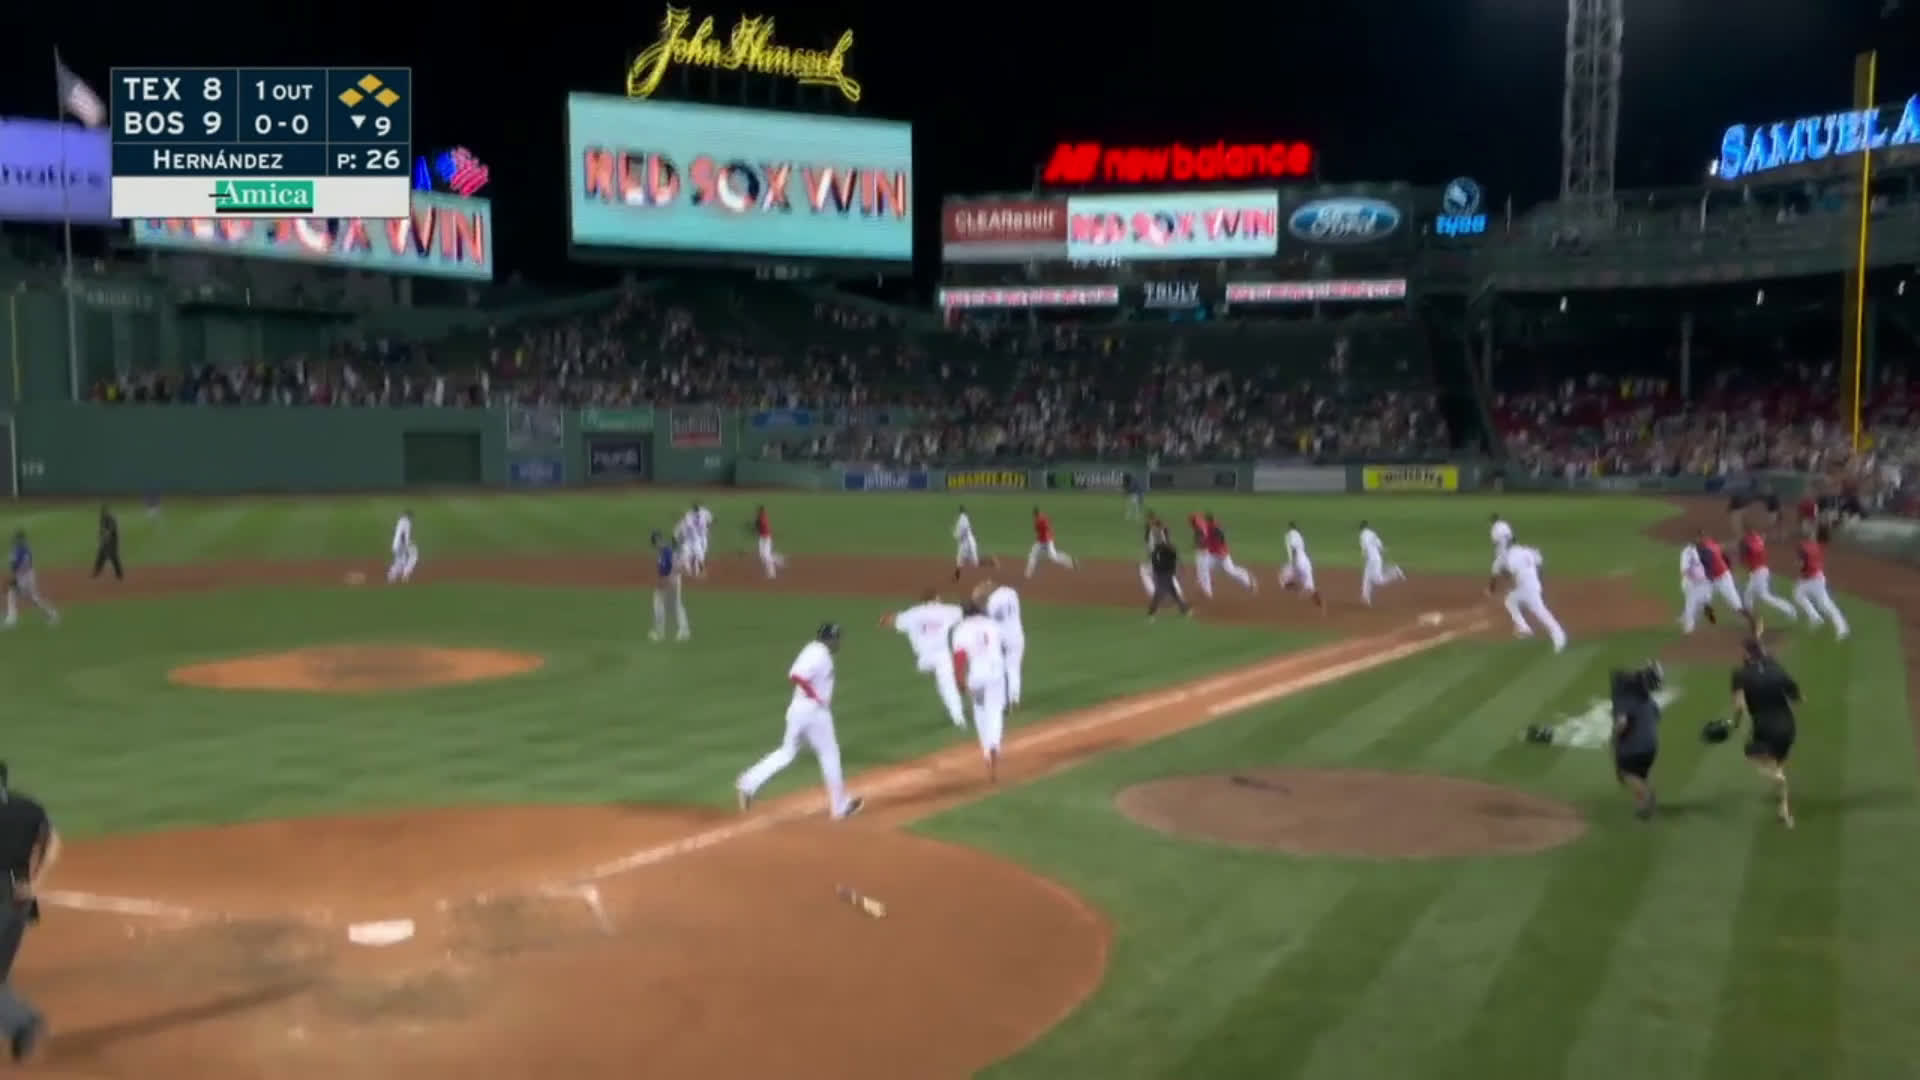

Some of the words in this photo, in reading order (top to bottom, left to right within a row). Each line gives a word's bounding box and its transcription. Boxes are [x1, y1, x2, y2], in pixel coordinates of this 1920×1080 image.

[628, 3, 722, 98] John
[722, 13, 861, 101] Hancock
[1104, 147, 1169, 184] new
[1172, 139, 1312, 182] balance
[1720, 108, 1888, 180] SAMUEL
[584, 146, 681, 207] RED
[691, 156, 793, 213] SOX
[803, 161, 906, 218] WIN
[1071, 211, 1127, 244] RED
[1203, 207, 1275, 241] WIN
